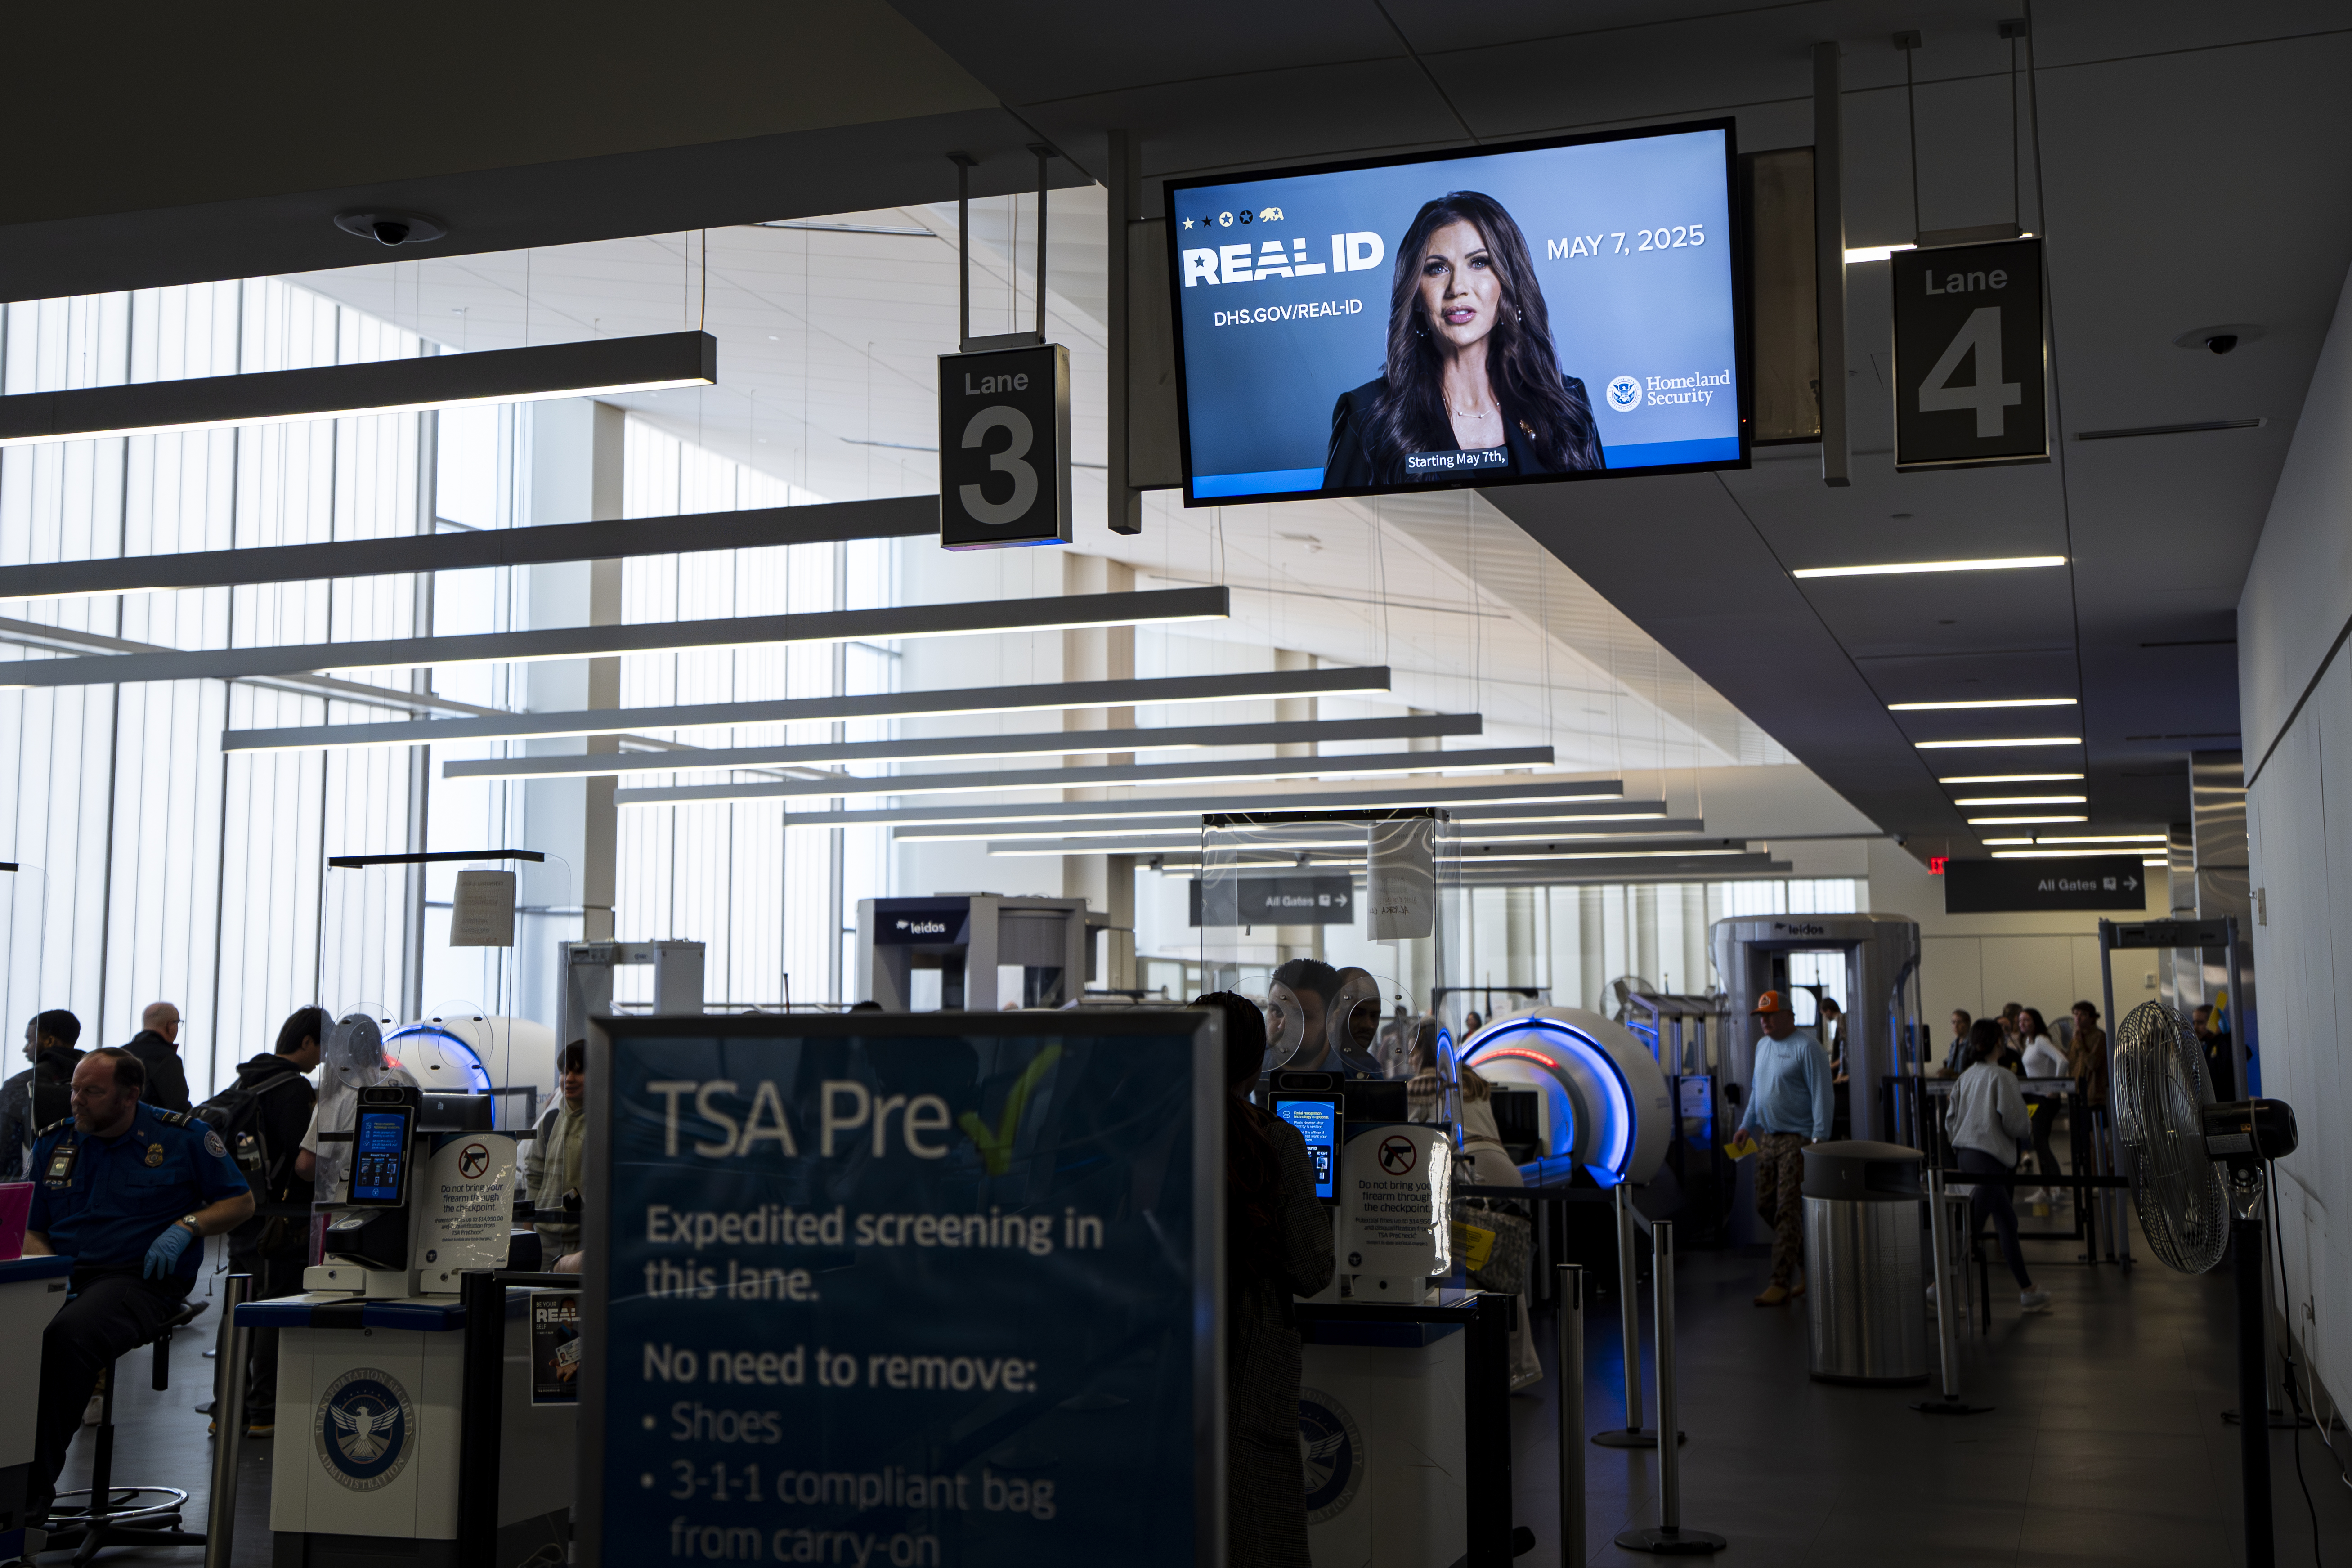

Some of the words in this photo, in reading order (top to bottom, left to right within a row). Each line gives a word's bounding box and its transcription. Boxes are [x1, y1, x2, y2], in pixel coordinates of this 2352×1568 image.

[1547, 234, 1604, 260] MAY
[1611, 232, 1630, 256] 7,
[1637, 224, 1705, 251] 2025
[1183, 237, 1326, 287] REAL
[1331, 231, 1384, 273] ID
[1926, 269, 2007, 295] Lane
[1214, 299, 1362, 327] DHS.GOV/REAL-ID
[965, 373, 1029, 395] Lane
[1646, 369, 1730, 391] Homeland
[1919, 306, 2022, 438] 4
[1648, 388, 1713, 406] Security
[959, 405, 1038, 524] 3
[1408, 455, 1454, 468] Starting
[1457, 453, 1480, 466] May
[1482, 450, 1505, 463] 7th,
[2038, 879, 2055, 891] All
[2059, 878, 2097, 891] Gates
[1265, 896, 1281, 907] All
[1282, 896, 1314, 907] Gates
[911, 920, 945, 934] leidos
[1788, 924, 1824, 935] leidos
[646, 1080, 797, 1159] TSA
[821, 1080, 954, 1159] Pre
[466, 1184, 484, 1192] bring
[487, 1184, 503, 1192] your
[1359, 1180, 1371, 1189] Do
[1373, 1181, 1387, 1189] not
[1390, 1181, 1413, 1191] bring
[1416, 1183, 1432, 1192] you
[1362, 1192, 1394, 1201] firearm
[1398, 1192, 1432, 1203] through
[443, 1194, 468, 1203] firearm
[443, 1204, 454, 1213] the
[1364, 1202, 1378, 1212] the
[1380, 1203, 1430, 1213] checkpoint.
[646, 1204, 846, 1250] Expedited
[856, 1208, 1053, 1256] screening
[1066, 1207, 1104, 1249] in
[643, 1259, 716, 1300] this
[728, 1260, 820, 1301] lane.
[536, 1308, 581, 1322] REAL
[642, 1342, 698, 1383] No
[708, 1343, 805, 1387] need
[817, 1345, 858, 1387] to
[868, 1353, 1038, 1392] remove:
[316, 1370, 387, 1436] TRANSPORTATION
[388, 1380, 413, 1435] SECURITY
[671, 1401, 784, 1445] Shoes
[320, 1454, 404, 1489] ADMINISTRATION
[670, 1459, 762, 1501] 3-1-1
[776, 1463, 968, 1509] compliant
[984, 1468, 1058, 1520] bag
[671, 1516, 762, 1559] from
[772, 1530, 941, 1568] carry-on
